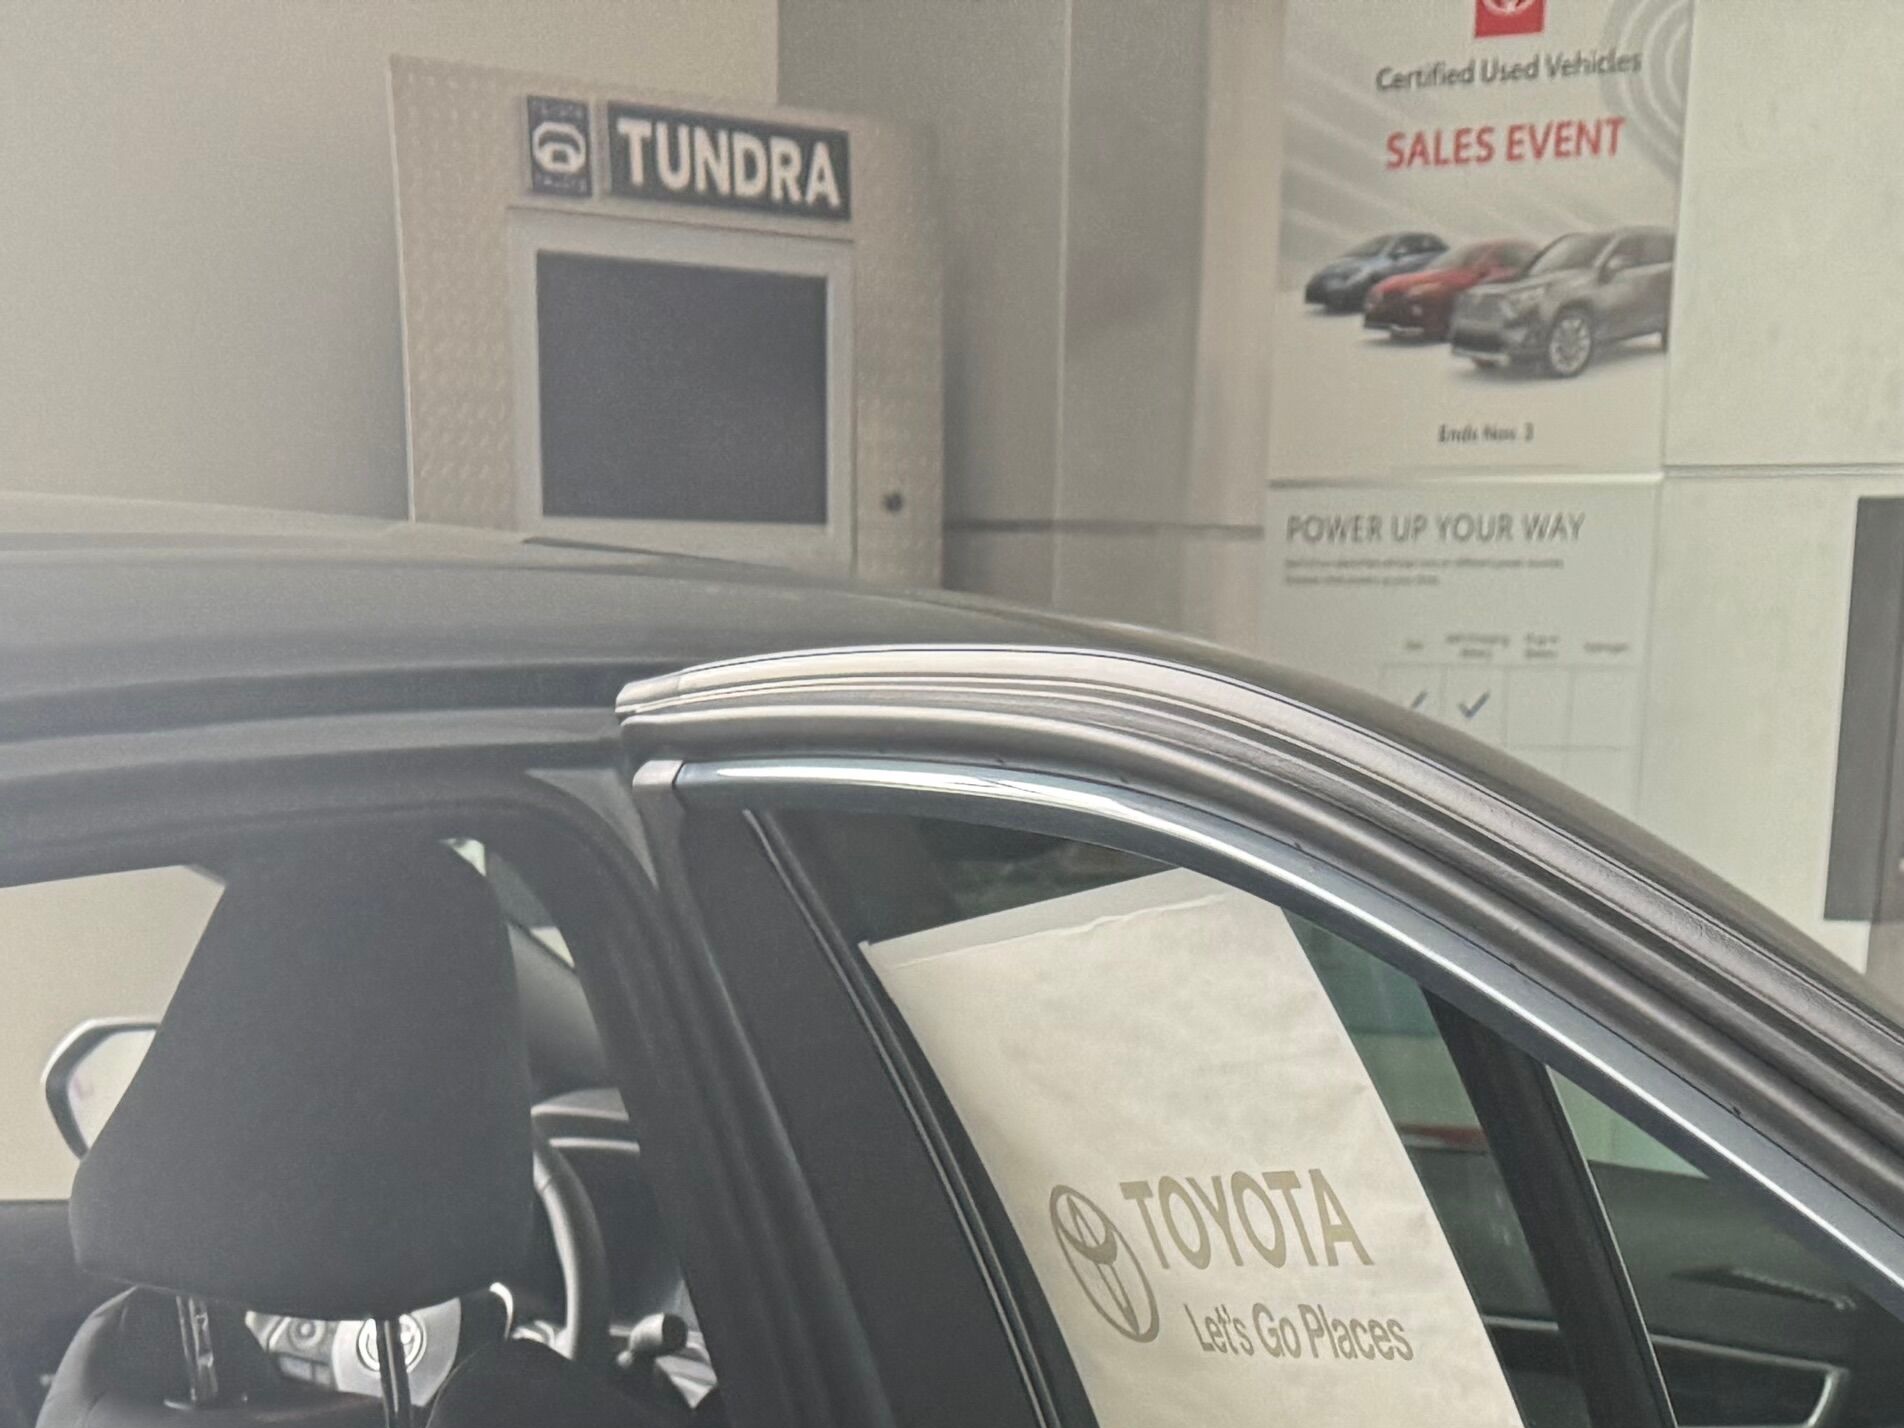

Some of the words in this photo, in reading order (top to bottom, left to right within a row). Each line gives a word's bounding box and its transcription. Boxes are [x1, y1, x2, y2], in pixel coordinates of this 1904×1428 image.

[1375, 58, 1476, 92] Certified
[1480, 52, 1540, 84] Used
[1545, 47, 1643, 79] Vehicles
[617, 117, 840, 207] TUNDRA
[1386, 124, 1496, 171] SALES
[1505, 114, 1628, 163] EVENT
[1437, 422, 1478, 443] Ends
[1285, 512, 1384, 544] POWER
[1390, 512, 1429, 544] UP
[1434, 511, 1514, 543] YOUR
[1520, 511, 1587, 542] WAY
[1119, 1168, 1375, 1269] TOYOTA
[1182, 1302, 1256, 1357] Let's
[1251, 1301, 1302, 1359] Go
[1297, 1303, 1415, 1362] Places
